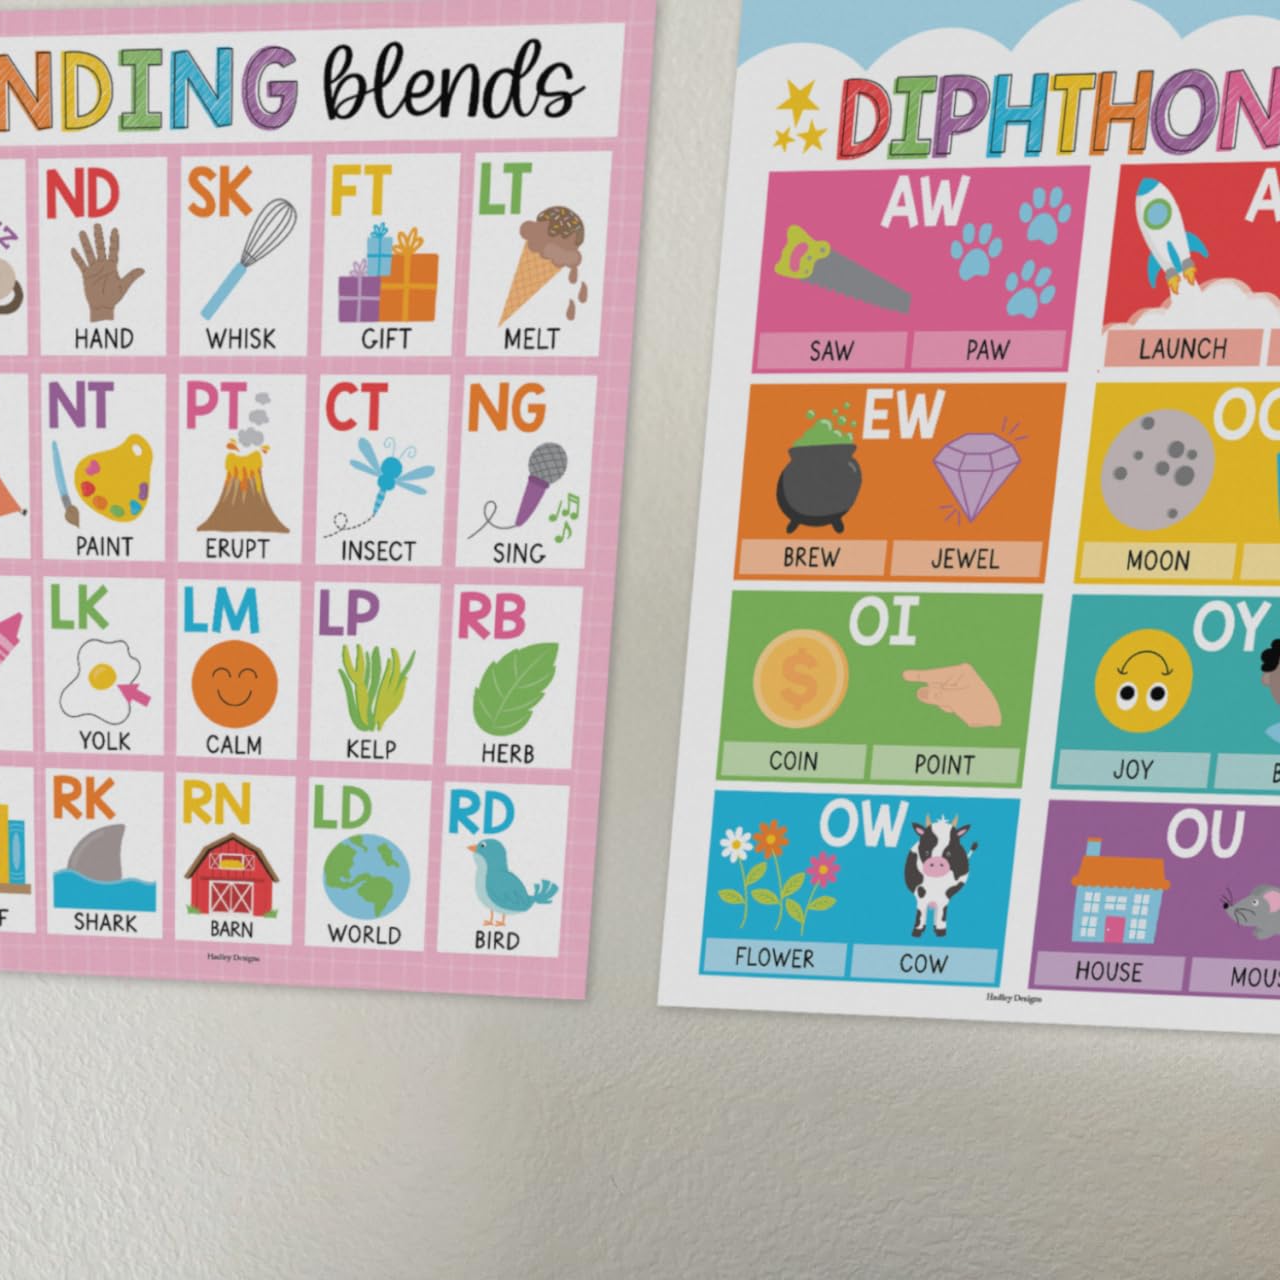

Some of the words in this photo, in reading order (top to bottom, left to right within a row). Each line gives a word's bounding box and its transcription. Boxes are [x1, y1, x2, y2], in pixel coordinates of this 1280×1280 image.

[323, 38, 586, 120] blends
[46, 167, 120, 219] ND
[187, 165, 253, 218] SK
[331, 164, 392, 217] FT
[478, 162, 533, 215] LT
[880, 174, 971, 229] AW
[74, 328, 134, 349] HAND
[206, 328, 277, 350] WHISK
[361, 328, 412, 350] GIFT
[504, 328, 560, 350] MELT
[1139, 337, 1227, 359] LAUNCH
[810, 340, 855, 362] SAW
[966, 339, 1011, 361] PAW
[48, 380, 114, 429] NT
[186, 380, 247, 430] PT
[325, 381, 389, 432] CT
[468, 382, 546, 433] NG
[862, 388, 946, 440] EW
[76, 536, 133, 557] PAINT
[206, 538, 270, 560] ERUPT
[341, 540, 416, 562] INSECT
[493, 543, 546, 564] SING
[783, 546, 841, 567] BREW
[931, 548, 1000, 570] JEWEL
[1126, 550, 1191, 572] MOON
[50, 583, 109, 630] LK
[184, 585, 260, 634] LM
[319, 589, 380, 637] LP
[458, 591, 526, 640] RB
[849, 595, 920, 647] OI
[1192, 599, 1272, 652] OY
[79, 731, 131, 751] YOLK
[206, 735, 262, 755] CALM
[347, 739, 397, 760] KELP
[482, 743, 535, 764] HERB
[769, 750, 818, 771] COIN
[915, 753, 976, 776] POINT
[1113, 759, 1155, 780] JOY
[53, 775, 116, 820] RK
[183, 779, 251, 825] RN
[313, 784, 372, 829] LD
[448, 788, 516, 835] RD
[819, 797, 910, 848] OW
[1166, 808, 1246, 859] OU
[74, 912, 137, 933] SHARK
[210, 920, 253, 938] BARN
[328, 924, 402, 945] WORLD
[475, 930, 520, 951] BIRD
[735, 946, 814, 968] FLOWER
[899, 953, 949, 974] COW
[1075, 960, 1144, 983] HOUSE
[1231, 966, 1280, 988] MOU
